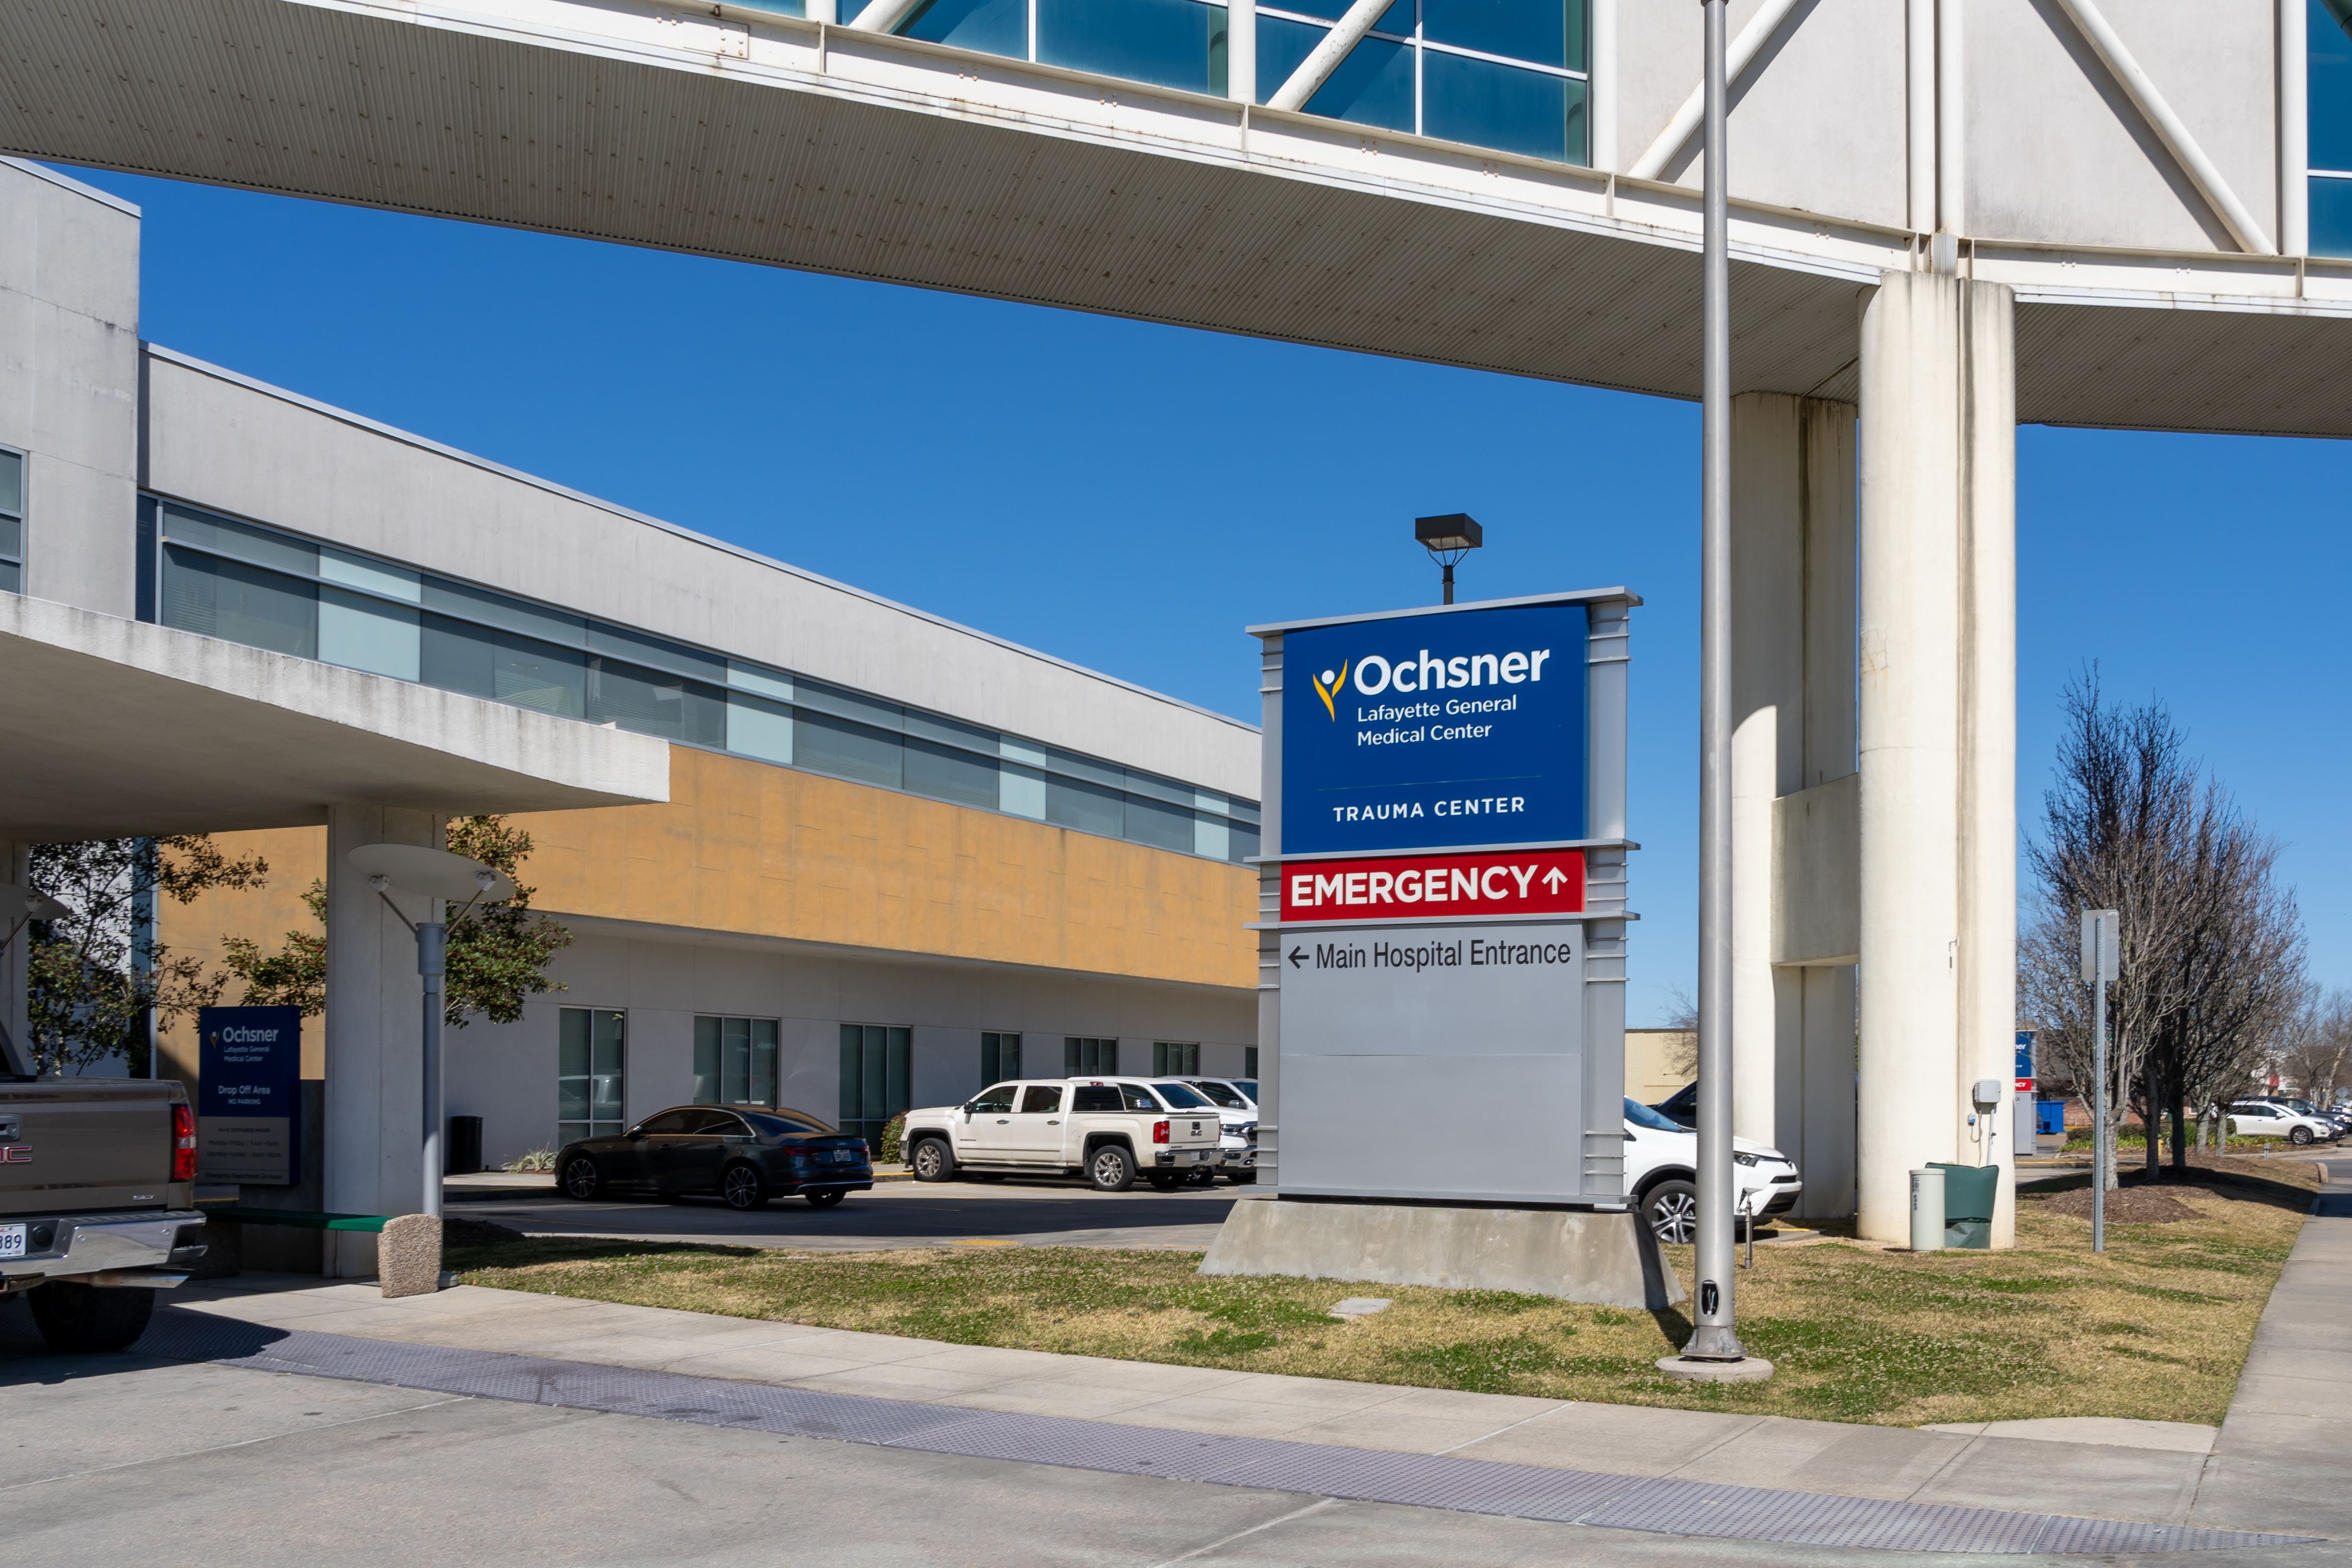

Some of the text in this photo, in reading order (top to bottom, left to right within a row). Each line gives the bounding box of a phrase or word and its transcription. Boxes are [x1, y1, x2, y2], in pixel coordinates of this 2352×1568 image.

[1354, 649, 1550, 696] Ochsner
[1358, 694, 1517, 722] Lafayette General
[1358, 724, 1492, 746] Medical Center
[1333, 796, 1525, 822] TRAUMA CENTER
[1292, 865, 1539, 907] EMERGENCY
[1316, 939, 1571, 973] Main Hospital Entrance
[223, 1026, 279, 1043] Ochsner
[218, 1085, 271, 1096] Drop Off Area
